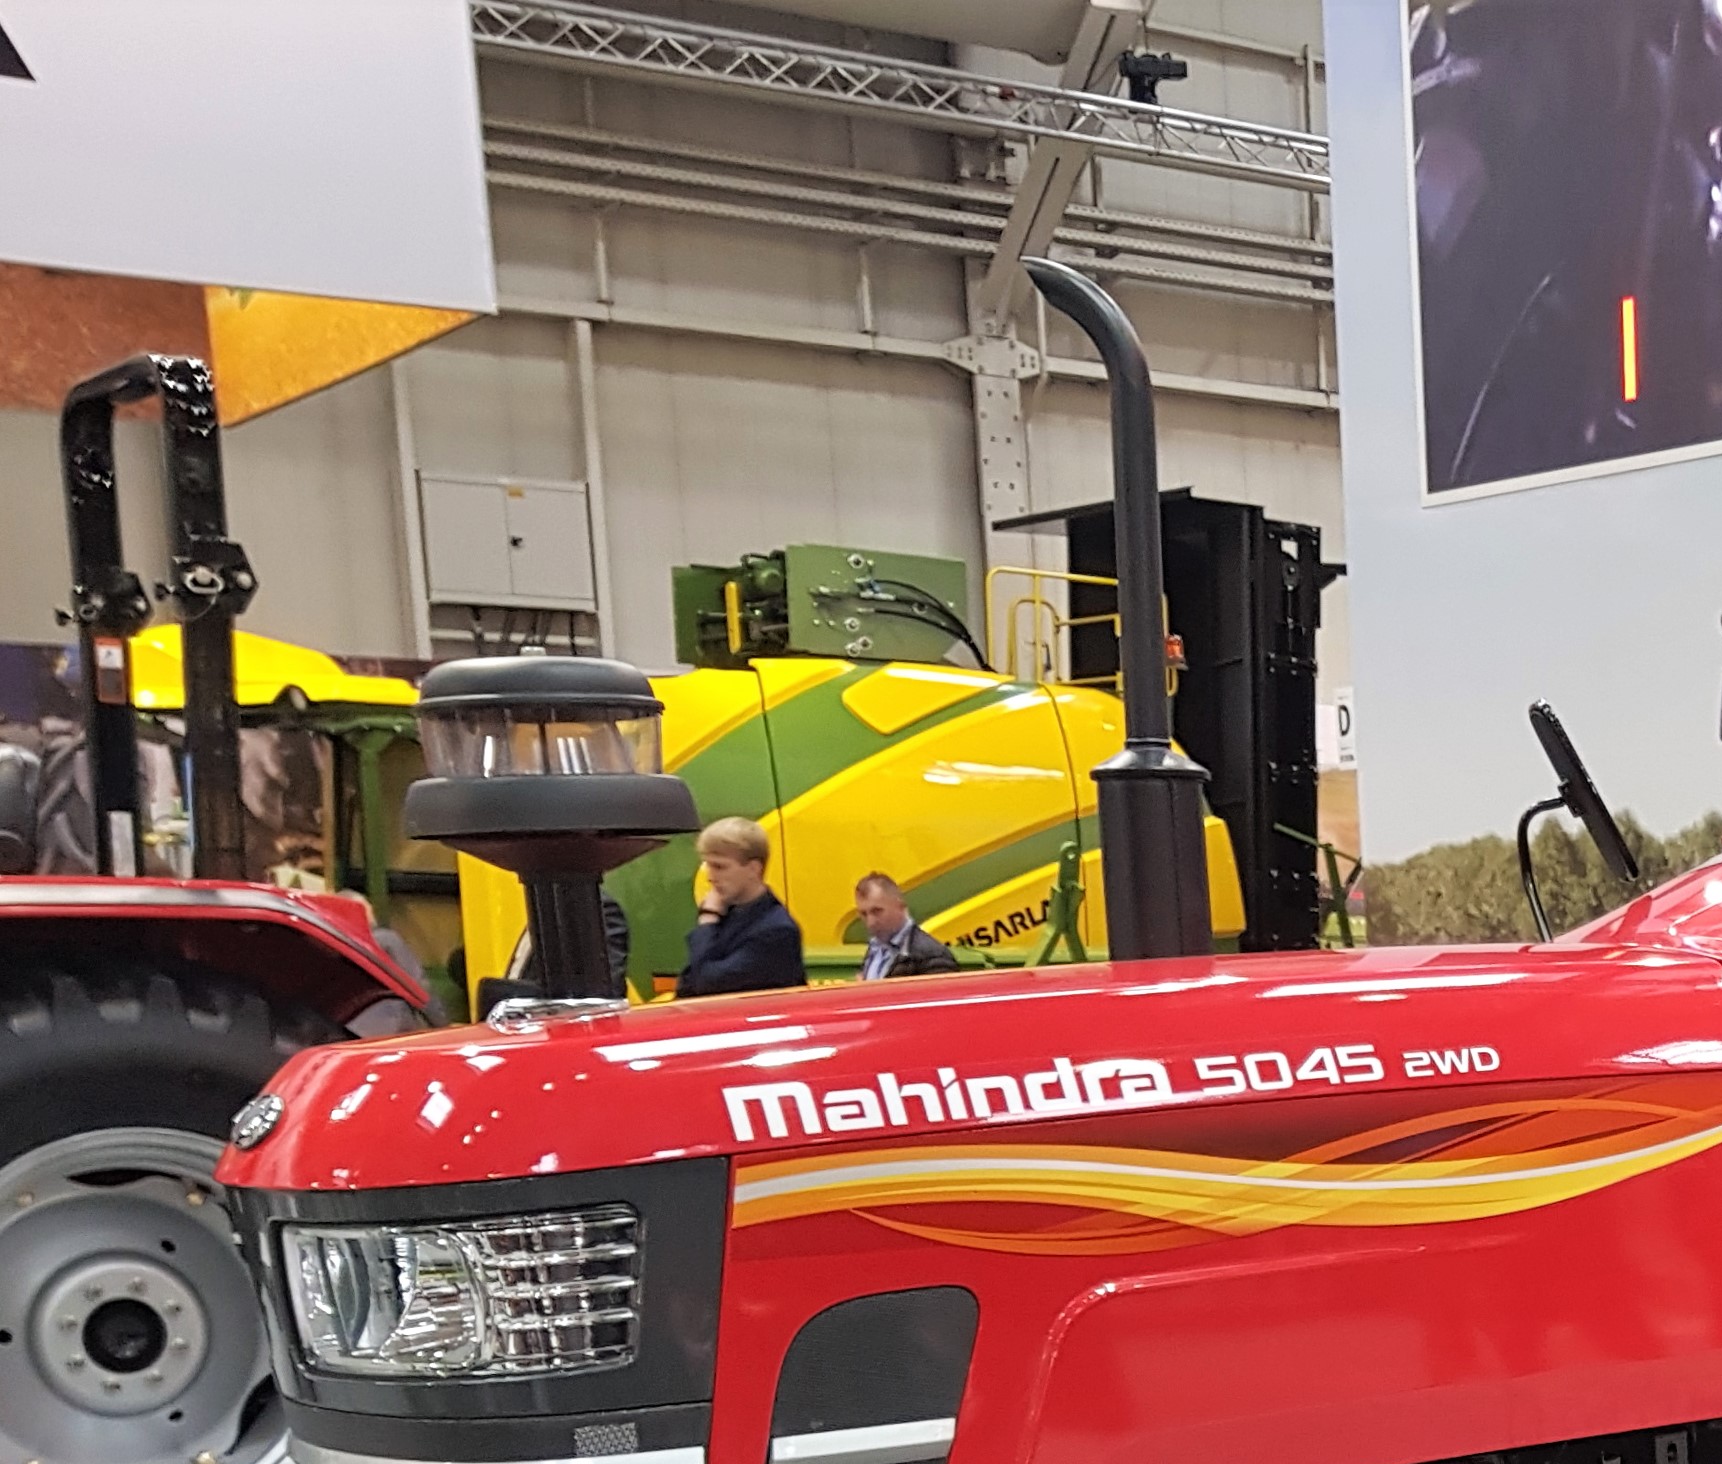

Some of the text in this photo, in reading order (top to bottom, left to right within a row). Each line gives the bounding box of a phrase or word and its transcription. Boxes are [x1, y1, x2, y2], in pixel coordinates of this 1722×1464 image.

[1338, 704, 1351, 738] D
[721, 1043, 1501, 1142] Mahindra 5045 2WD
